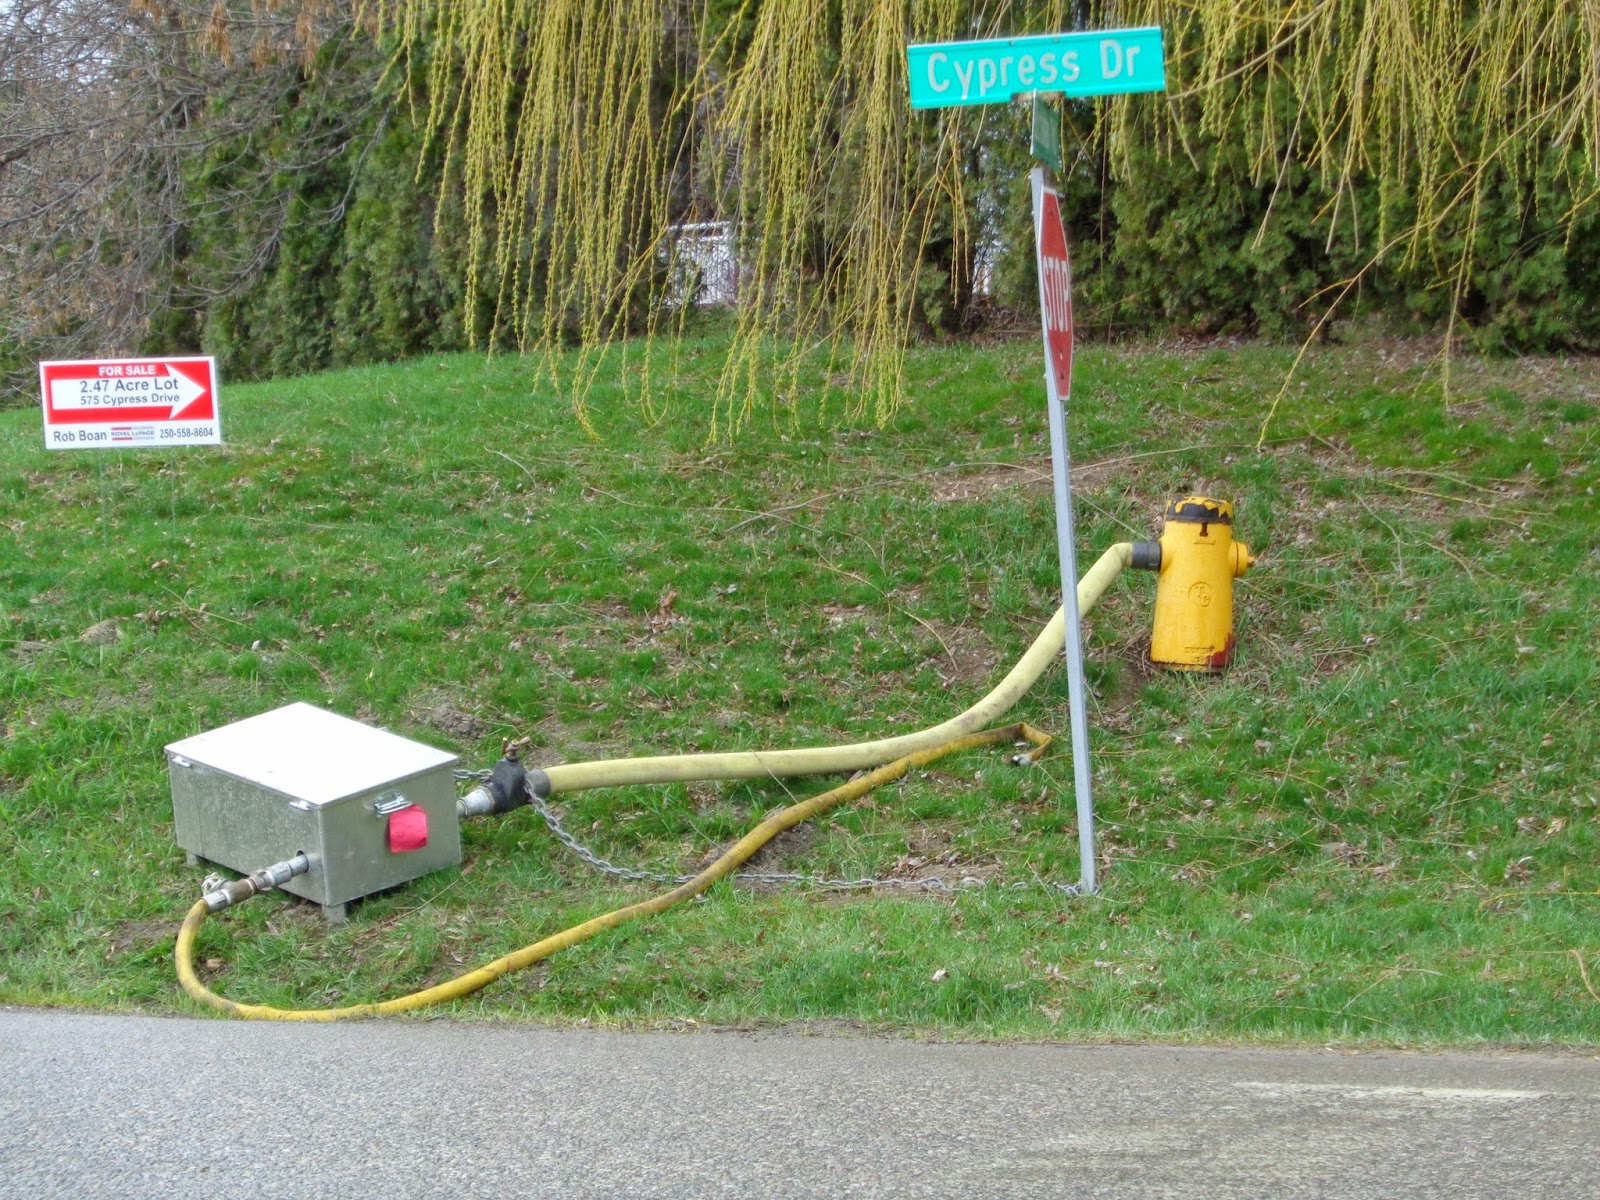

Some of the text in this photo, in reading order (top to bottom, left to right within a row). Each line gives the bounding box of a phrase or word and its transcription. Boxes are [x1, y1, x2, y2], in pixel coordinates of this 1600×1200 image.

[927, 39, 1141, 100] Cypress Dr
[1042, 255, 1070, 332] STOP
[98, 364, 156, 377] FOR SALE
[79, 377, 179, 393] 2.47 Acre Lot
[80, 393, 180, 407] 575 Cypress Drive
[53, 430, 107, 442] Rob Boan
[159, 427, 213, 439] 250-558-8604
